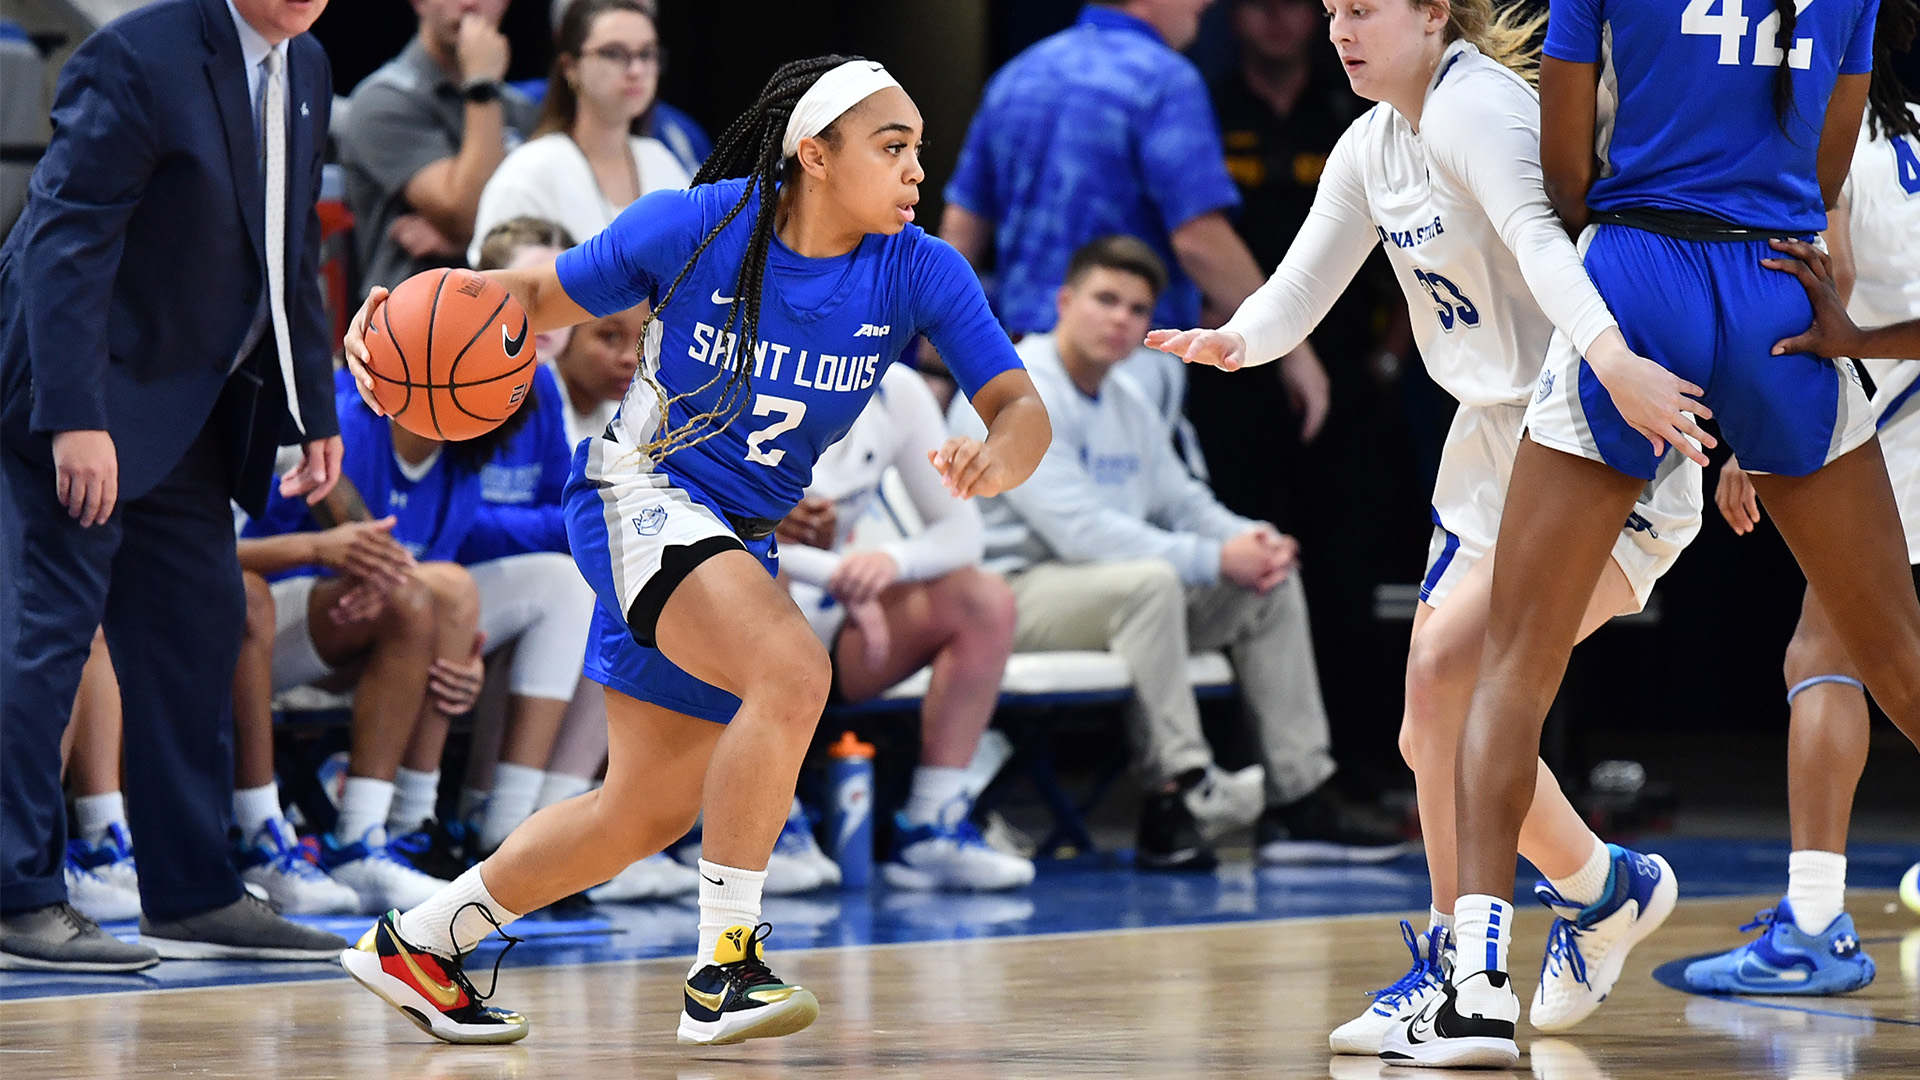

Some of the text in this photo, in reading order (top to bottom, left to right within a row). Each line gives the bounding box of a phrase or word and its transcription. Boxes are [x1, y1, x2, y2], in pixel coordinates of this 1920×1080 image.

[1681, 0, 1814, 70] 42
[1413, 265, 1482, 333] 33
[793, 349, 880, 392] LOUIS
[744, 393, 807, 467] 2
